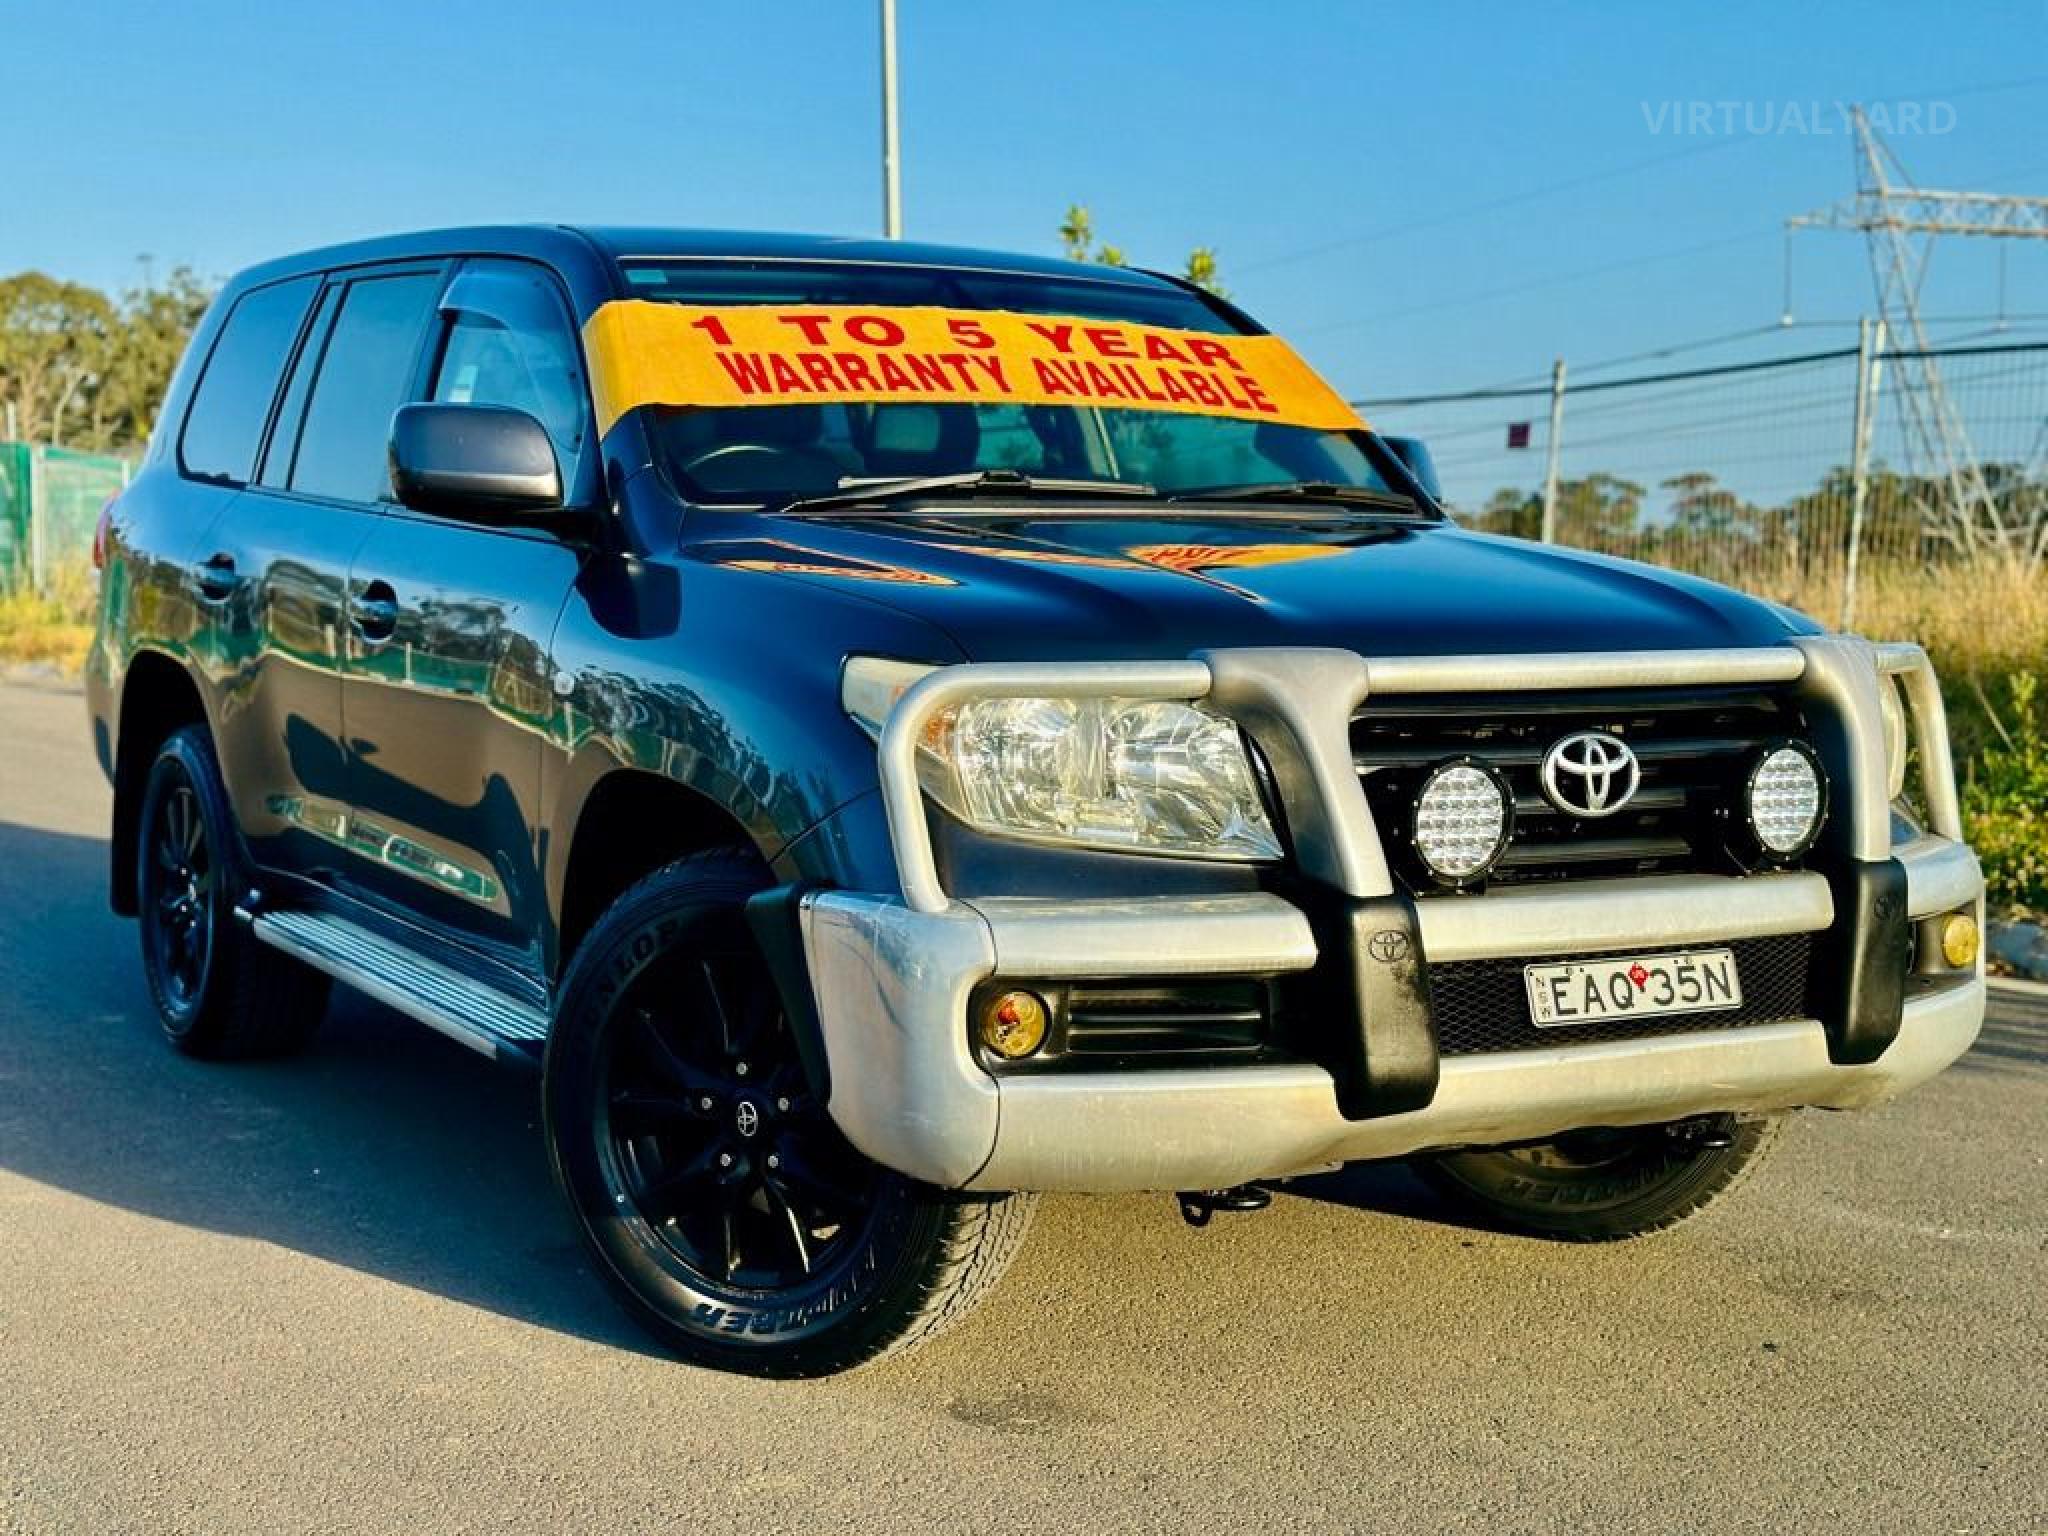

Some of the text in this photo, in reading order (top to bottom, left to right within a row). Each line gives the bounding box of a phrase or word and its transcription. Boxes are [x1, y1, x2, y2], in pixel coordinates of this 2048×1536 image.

[690, 315, 1245, 371] 1 TO 5 YEAR
[714, 352, 1280, 413] WARRANTY AVAILABLE
